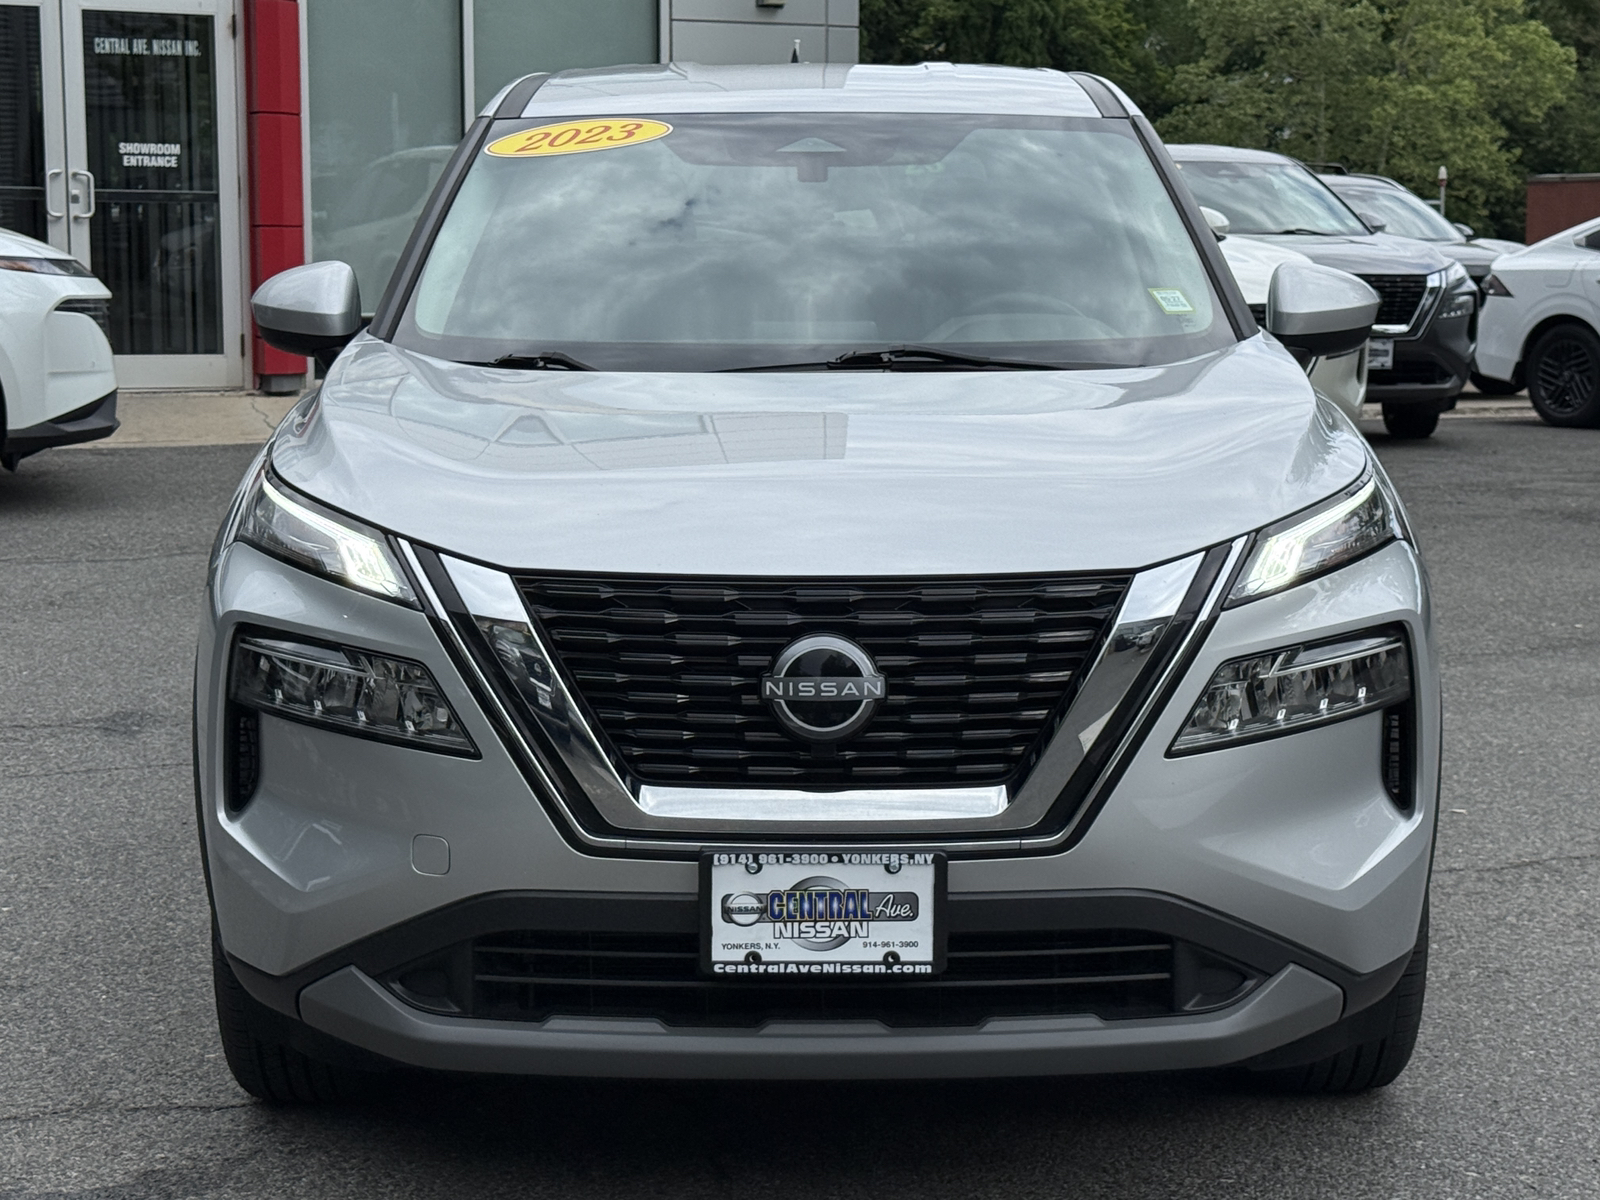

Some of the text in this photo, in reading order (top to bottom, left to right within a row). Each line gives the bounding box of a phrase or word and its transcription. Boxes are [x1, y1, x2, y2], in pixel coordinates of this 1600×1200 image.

[94, 37, 201, 56] CENTRAL AVE. NISSAN INC.
[514, 122, 643, 152] 2023
[118, 142, 181, 155] SHOWROOM
[123, 155, 178, 167] ENTRANCE
[765, 681, 881, 696] NISSAN
[758, 853, 829, 864] 961-3900
[767, 889, 914, 921] CENTRAL Ave.
[773, 921, 869, 939] NISSAN
[721, 943, 763, 951] YONKERS,
[713, 962, 933, 973] CentralAveNissan.com
